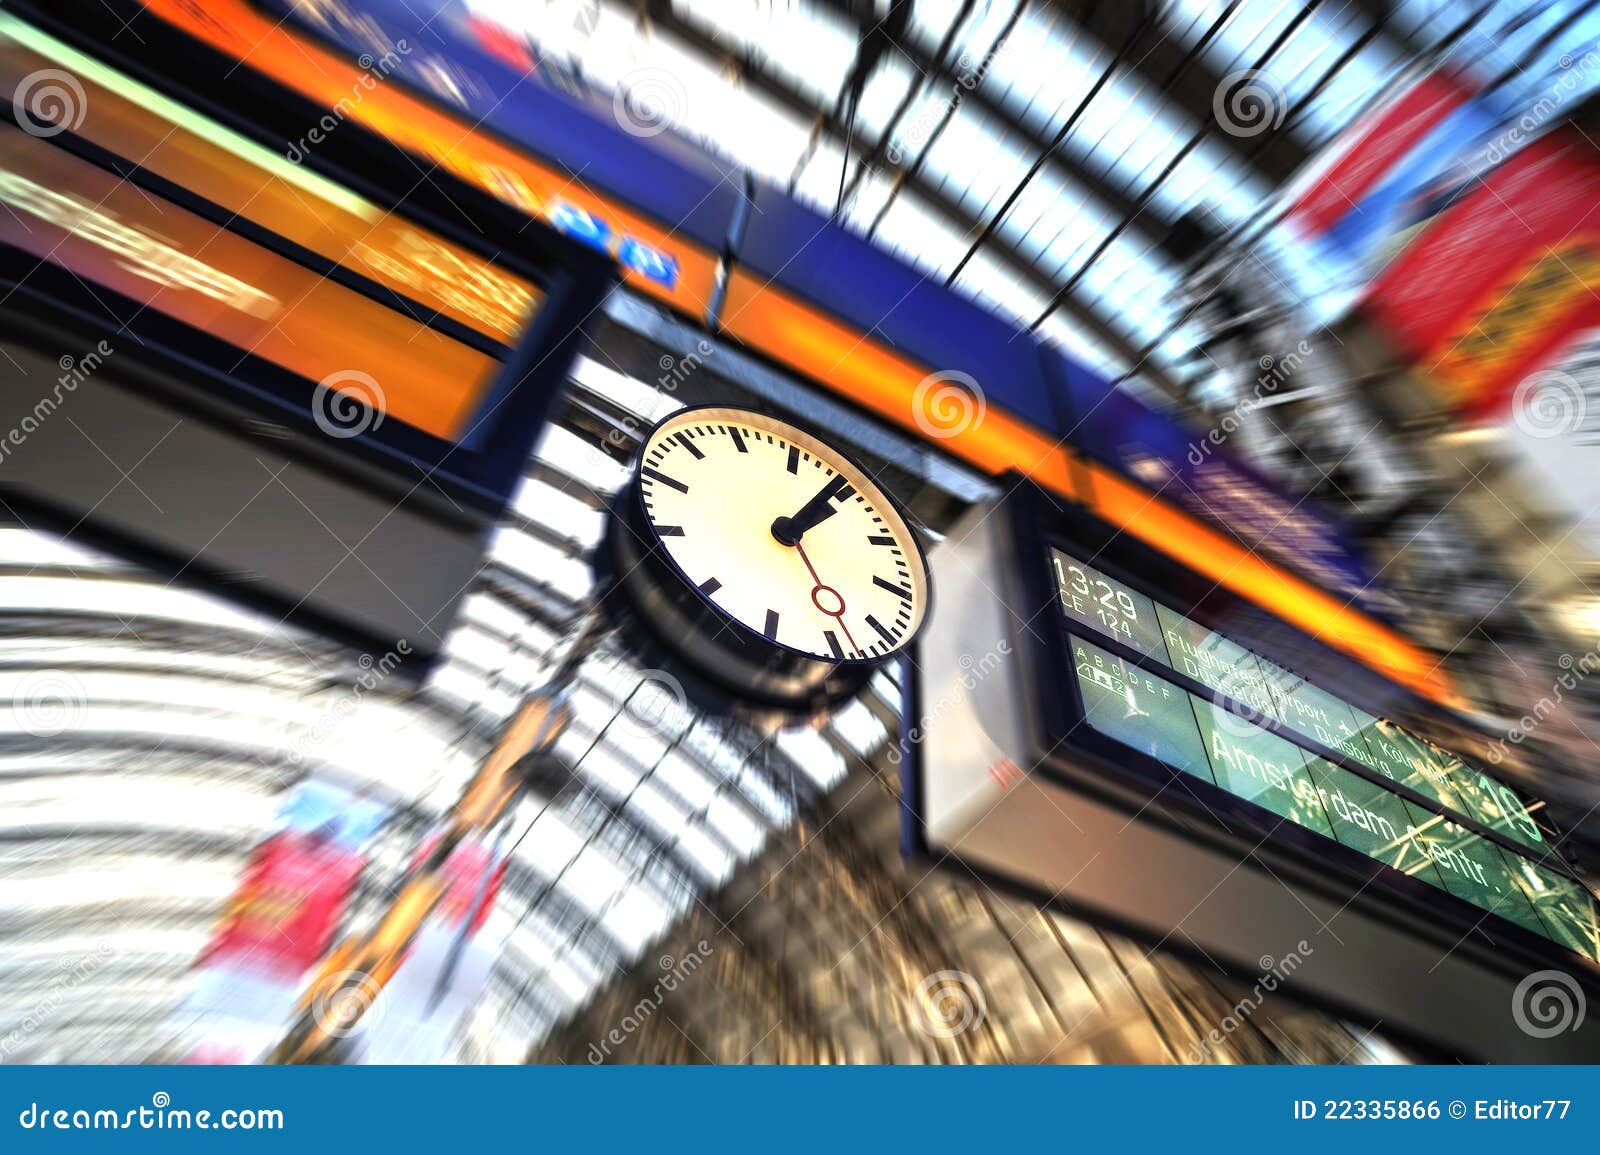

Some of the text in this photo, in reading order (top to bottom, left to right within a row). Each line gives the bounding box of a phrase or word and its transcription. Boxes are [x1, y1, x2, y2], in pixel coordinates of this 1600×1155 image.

[1053, 557, 1137, 621] 13:29
[1097, 609, 1132, 638] 124
[1076, 647, 1170, 700] A B C D E F
[1313, 722, 1394, 780] Duisburg
[1211, 730, 1402, 846] Amsterdam
[1478, 775, 1543, 842] 19
